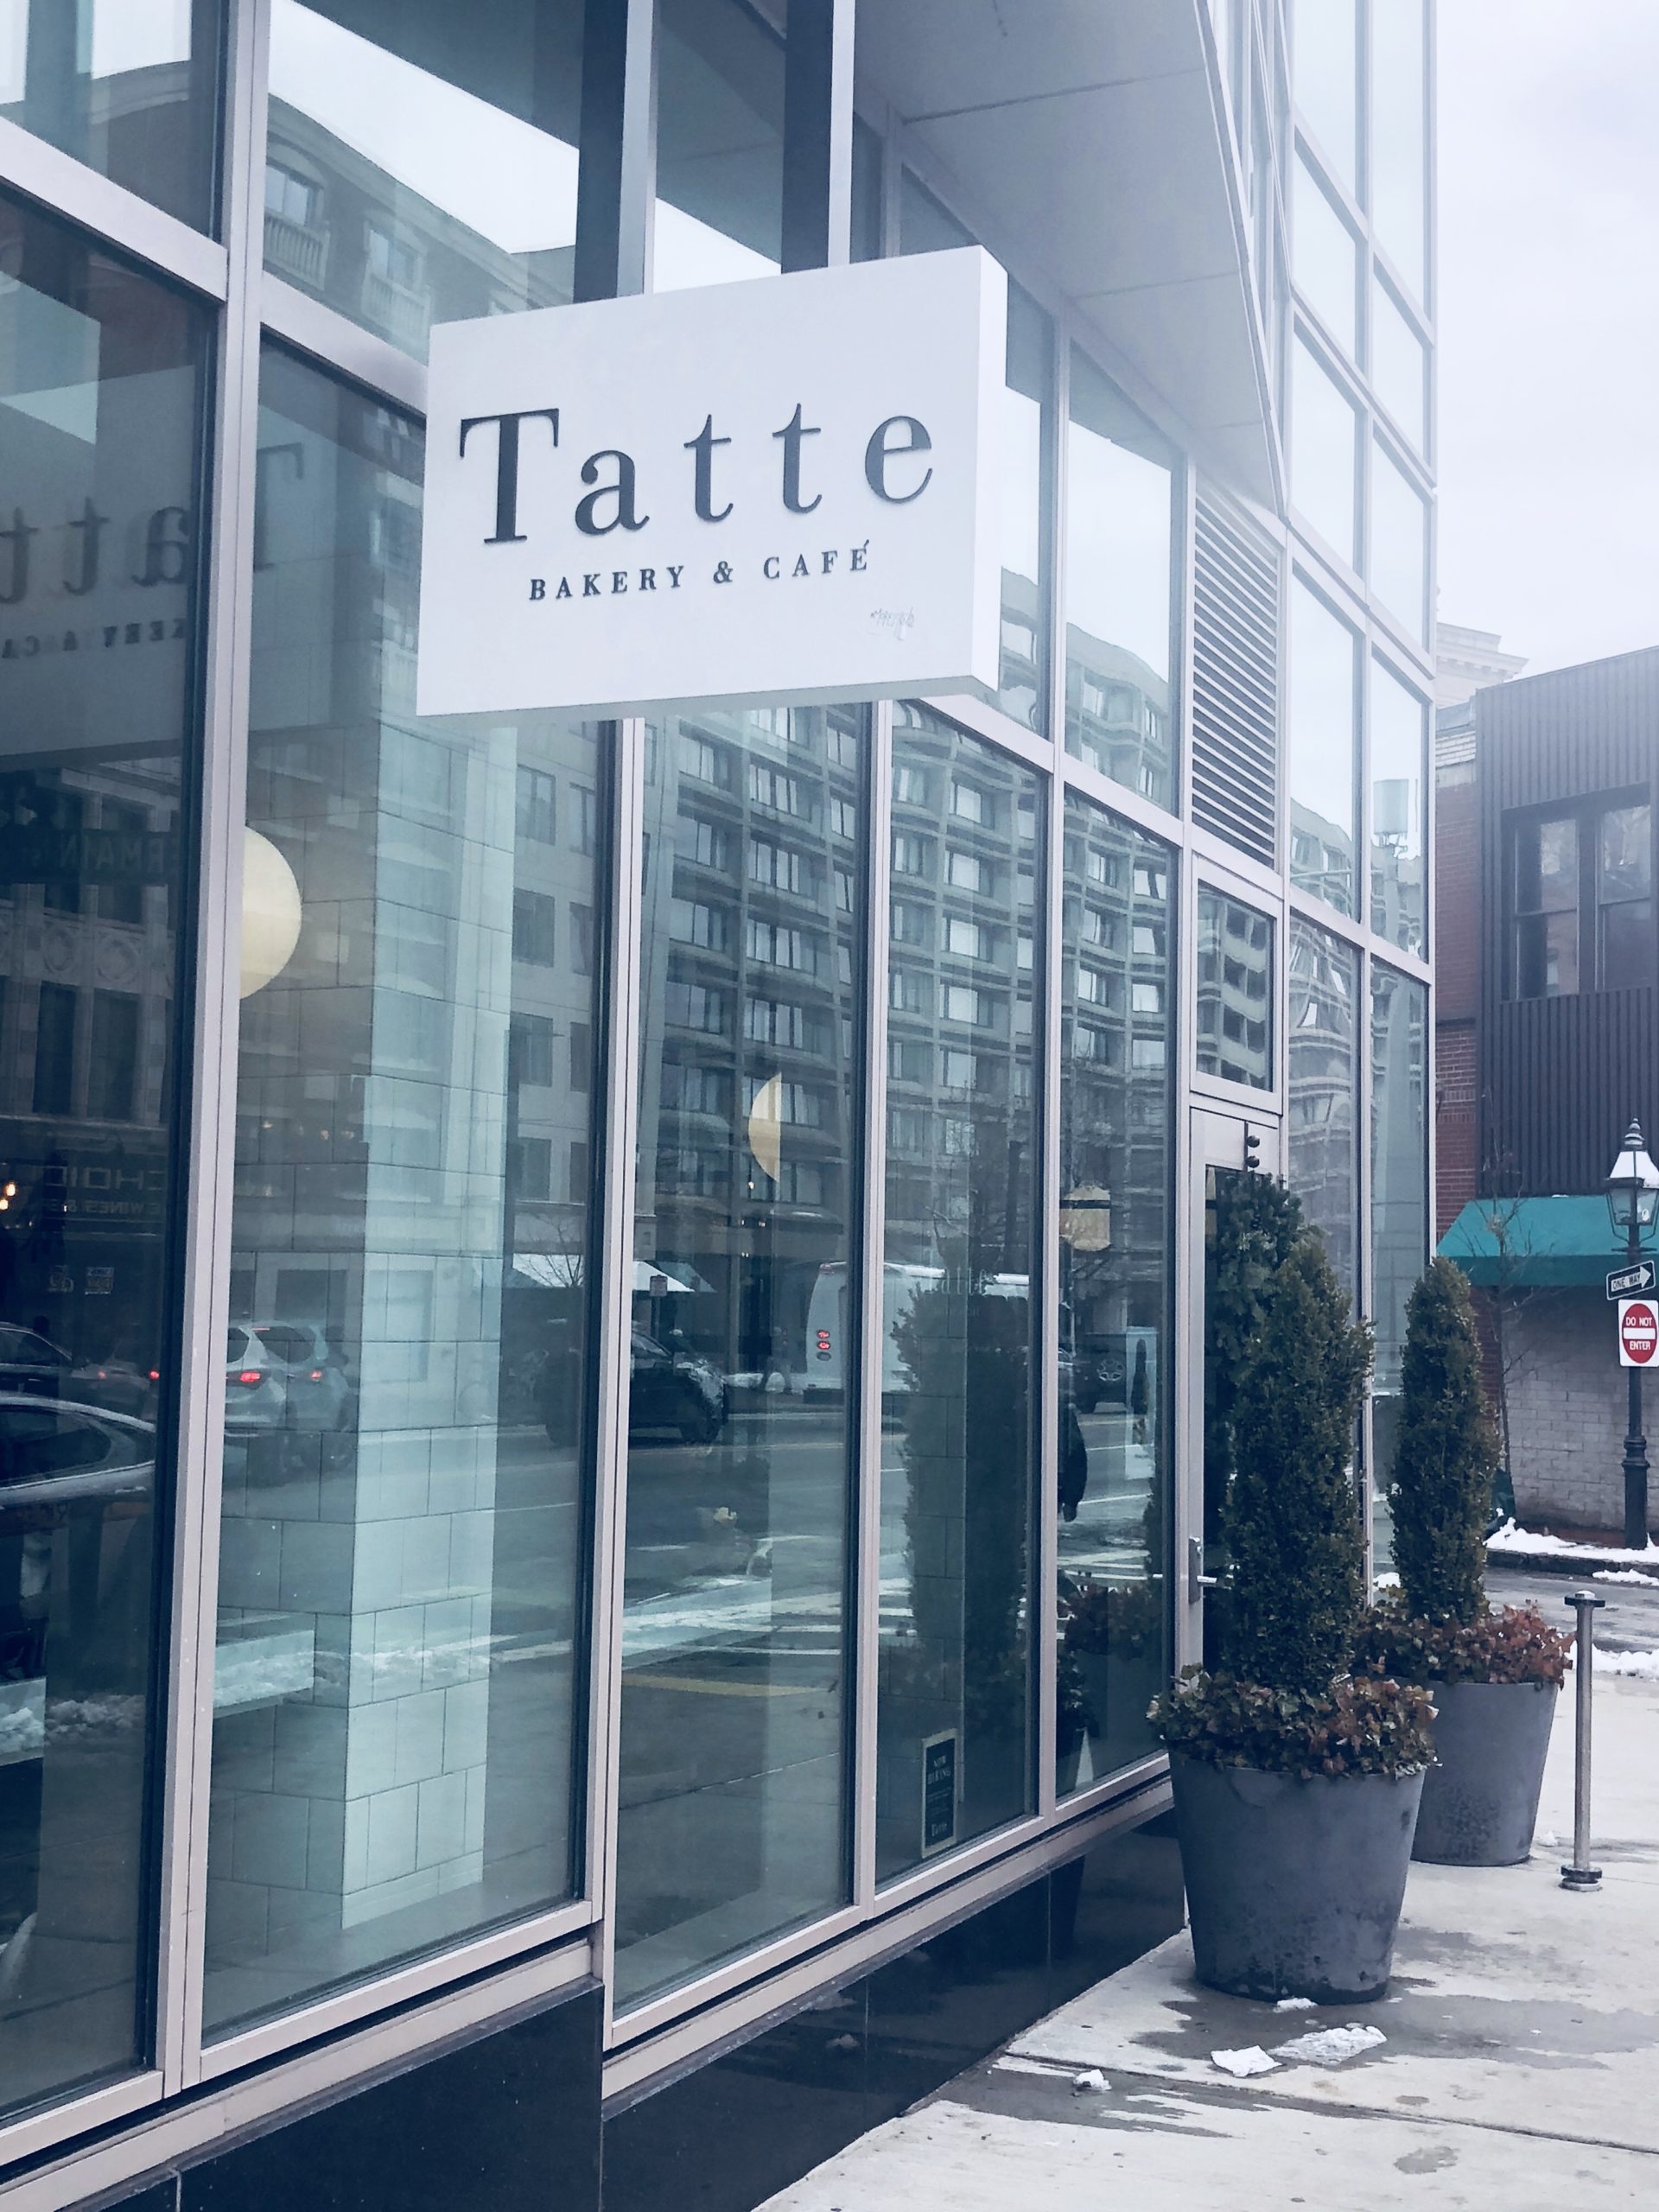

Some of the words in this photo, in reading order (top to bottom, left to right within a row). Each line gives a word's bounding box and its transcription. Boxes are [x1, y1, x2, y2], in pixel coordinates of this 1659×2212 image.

[459, 403, 933, 543] Tatte
[529, 564, 685, 601] BAKERY
[712, 560, 734, 583] &
[763, 539, 870, 580] CAFÉ
[1612, 1278, 1626, 1290] ONE
[1629, 1273, 1642, 1287] WAY
[1625, 1317, 1636, 1326] DO
[1638, 1317, 1653, 1327] NOT
[1629, 1340, 1651, 1351] ENTER
